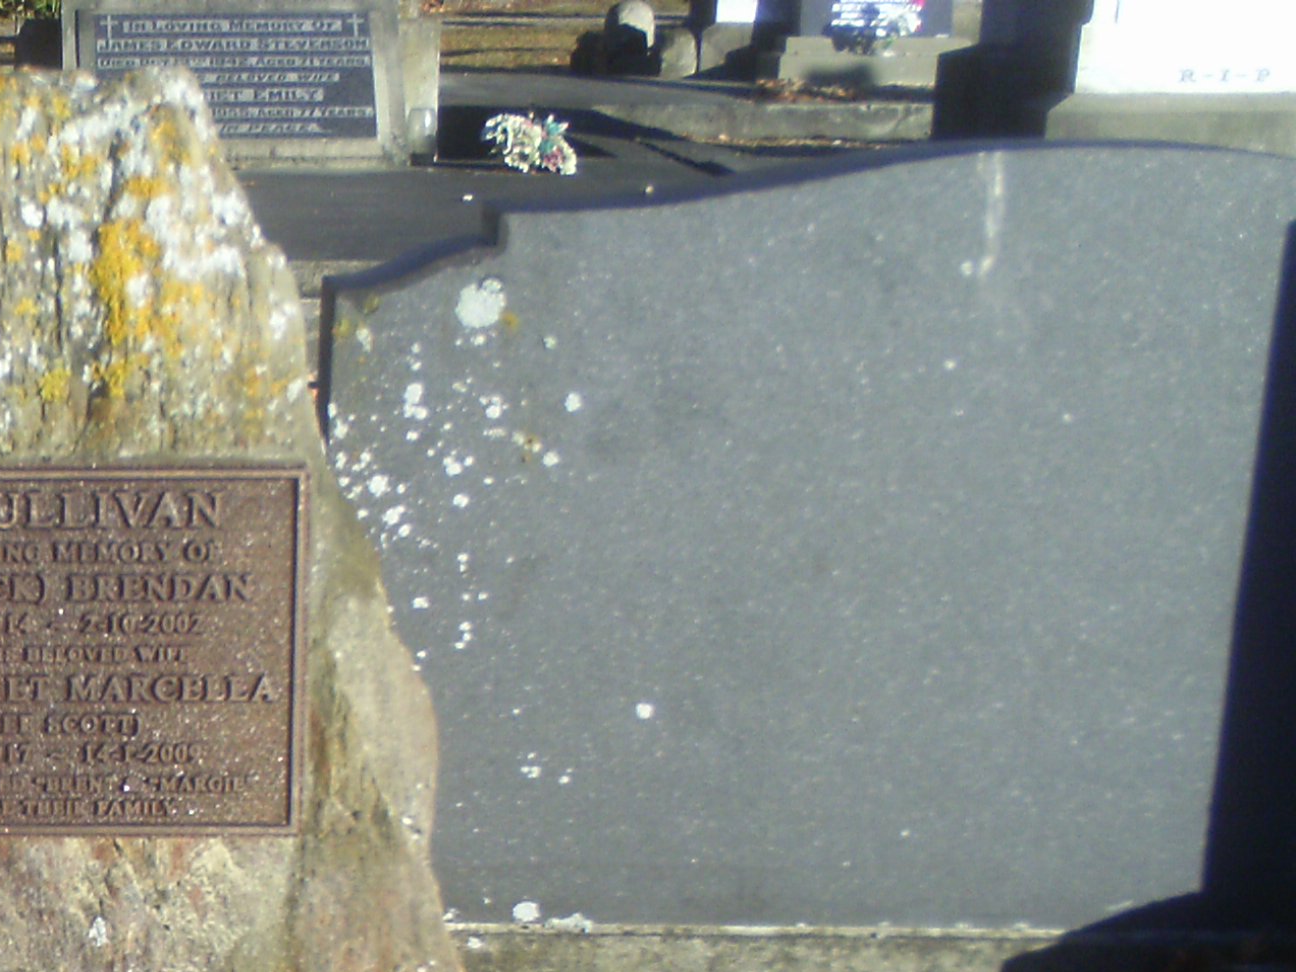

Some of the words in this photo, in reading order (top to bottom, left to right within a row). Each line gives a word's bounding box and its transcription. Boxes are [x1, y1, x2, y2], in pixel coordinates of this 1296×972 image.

[152, 21, 221, 32] LOVING
[228, 20, 304, 32] MEMORY
[254, 88, 318, 101] EMILY
[53, 540, 173, 564] MEMORY
[183, 540, 223, 564] OF
[66, 572, 255, 602] BRENDAN
[22, 645, 128, 664] BELOVED
[134, 645, 191, 664] WIFE
[66, 673, 275, 703] MARCELLA
[43, 712, 143, 738] SCOTT)
[19, 799, 90, 817] THEIR
[92, 799, 175, 818] FAMILY
